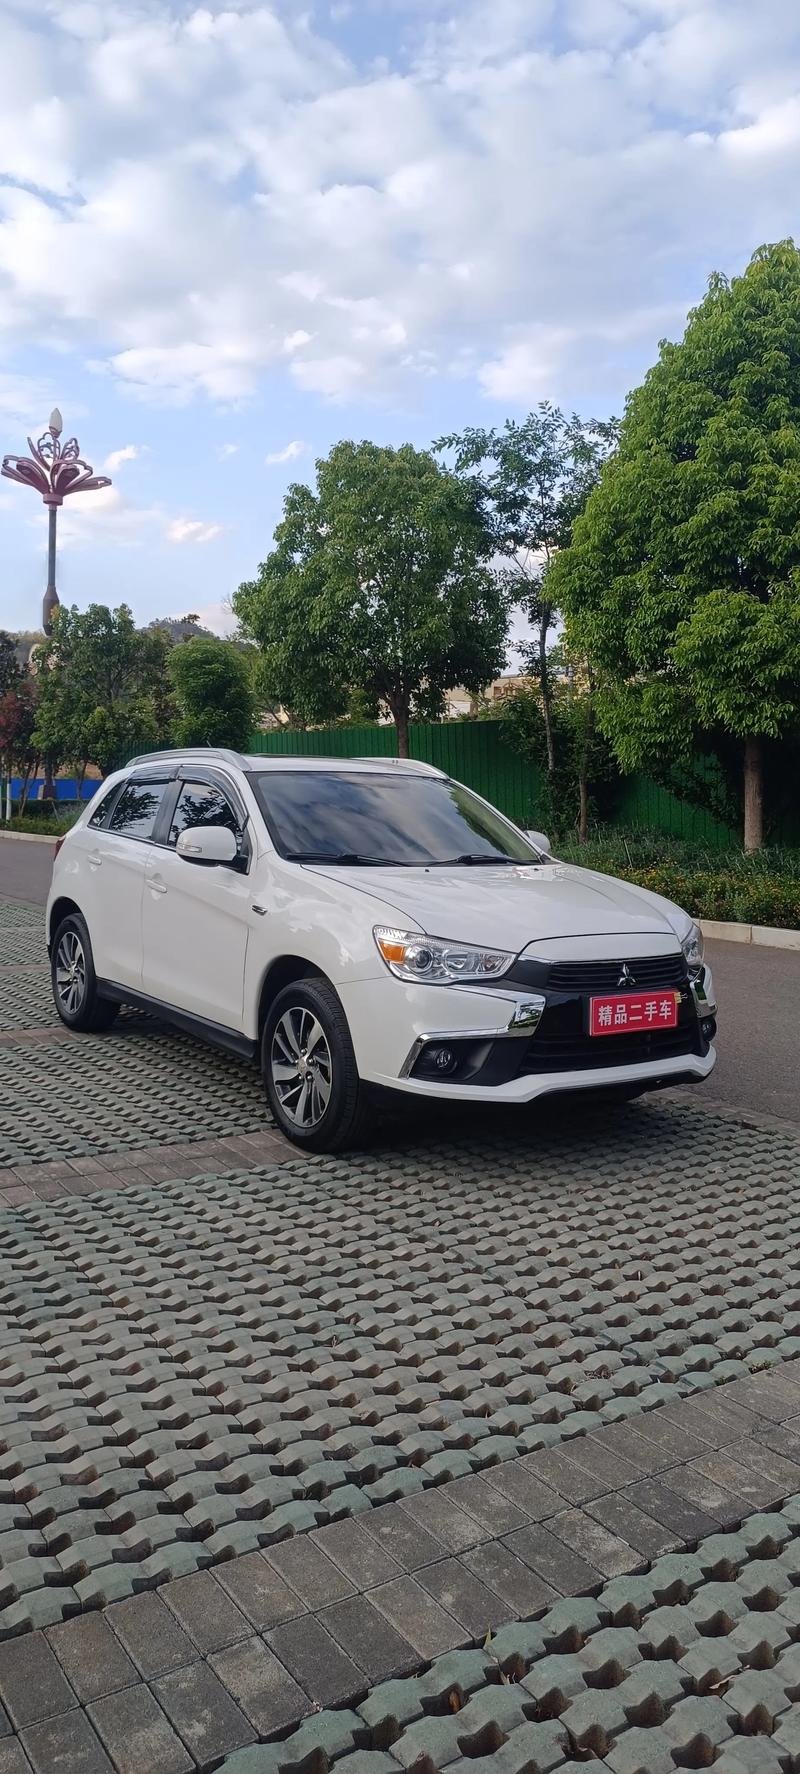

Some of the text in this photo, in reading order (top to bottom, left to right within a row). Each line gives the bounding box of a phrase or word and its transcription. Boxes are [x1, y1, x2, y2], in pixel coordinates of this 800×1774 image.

[598, 1000, 672, 1026] 精品二手车
